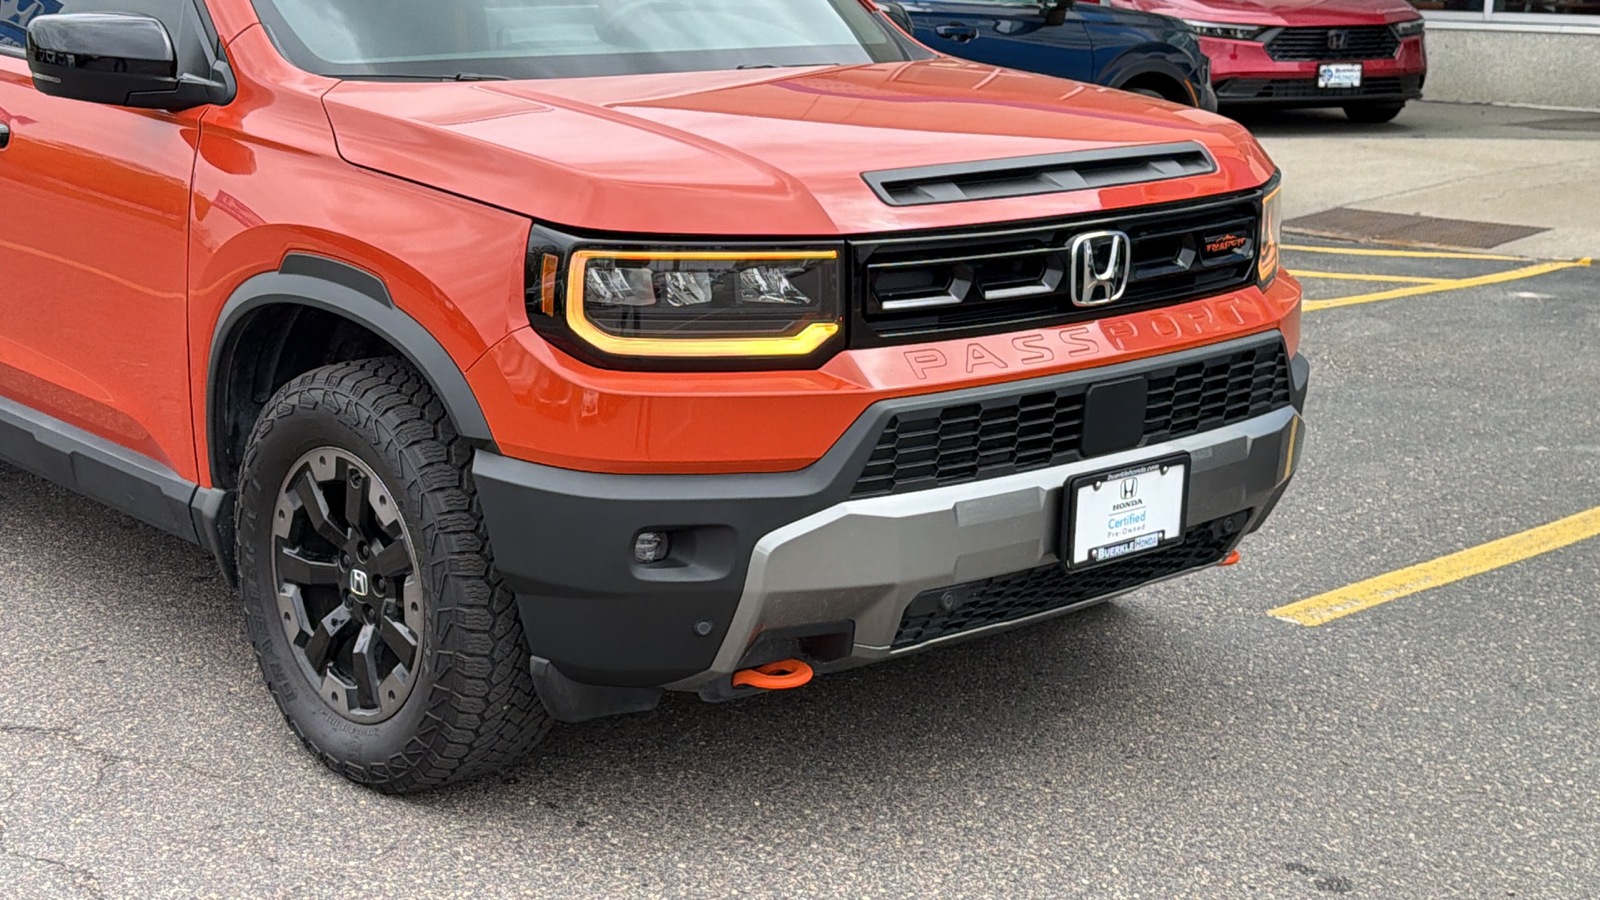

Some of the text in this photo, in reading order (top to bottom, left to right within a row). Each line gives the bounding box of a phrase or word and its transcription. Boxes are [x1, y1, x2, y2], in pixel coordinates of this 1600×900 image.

[904, 297, 1244, 380] PASSPORT
[1112, 498, 1143, 511] HONDA
[1108, 511, 1146, 530] Certified
[1107, 524, 1146, 539] Pre-Owned
[1097, 535, 1158, 559] BUERKLE HONDA
